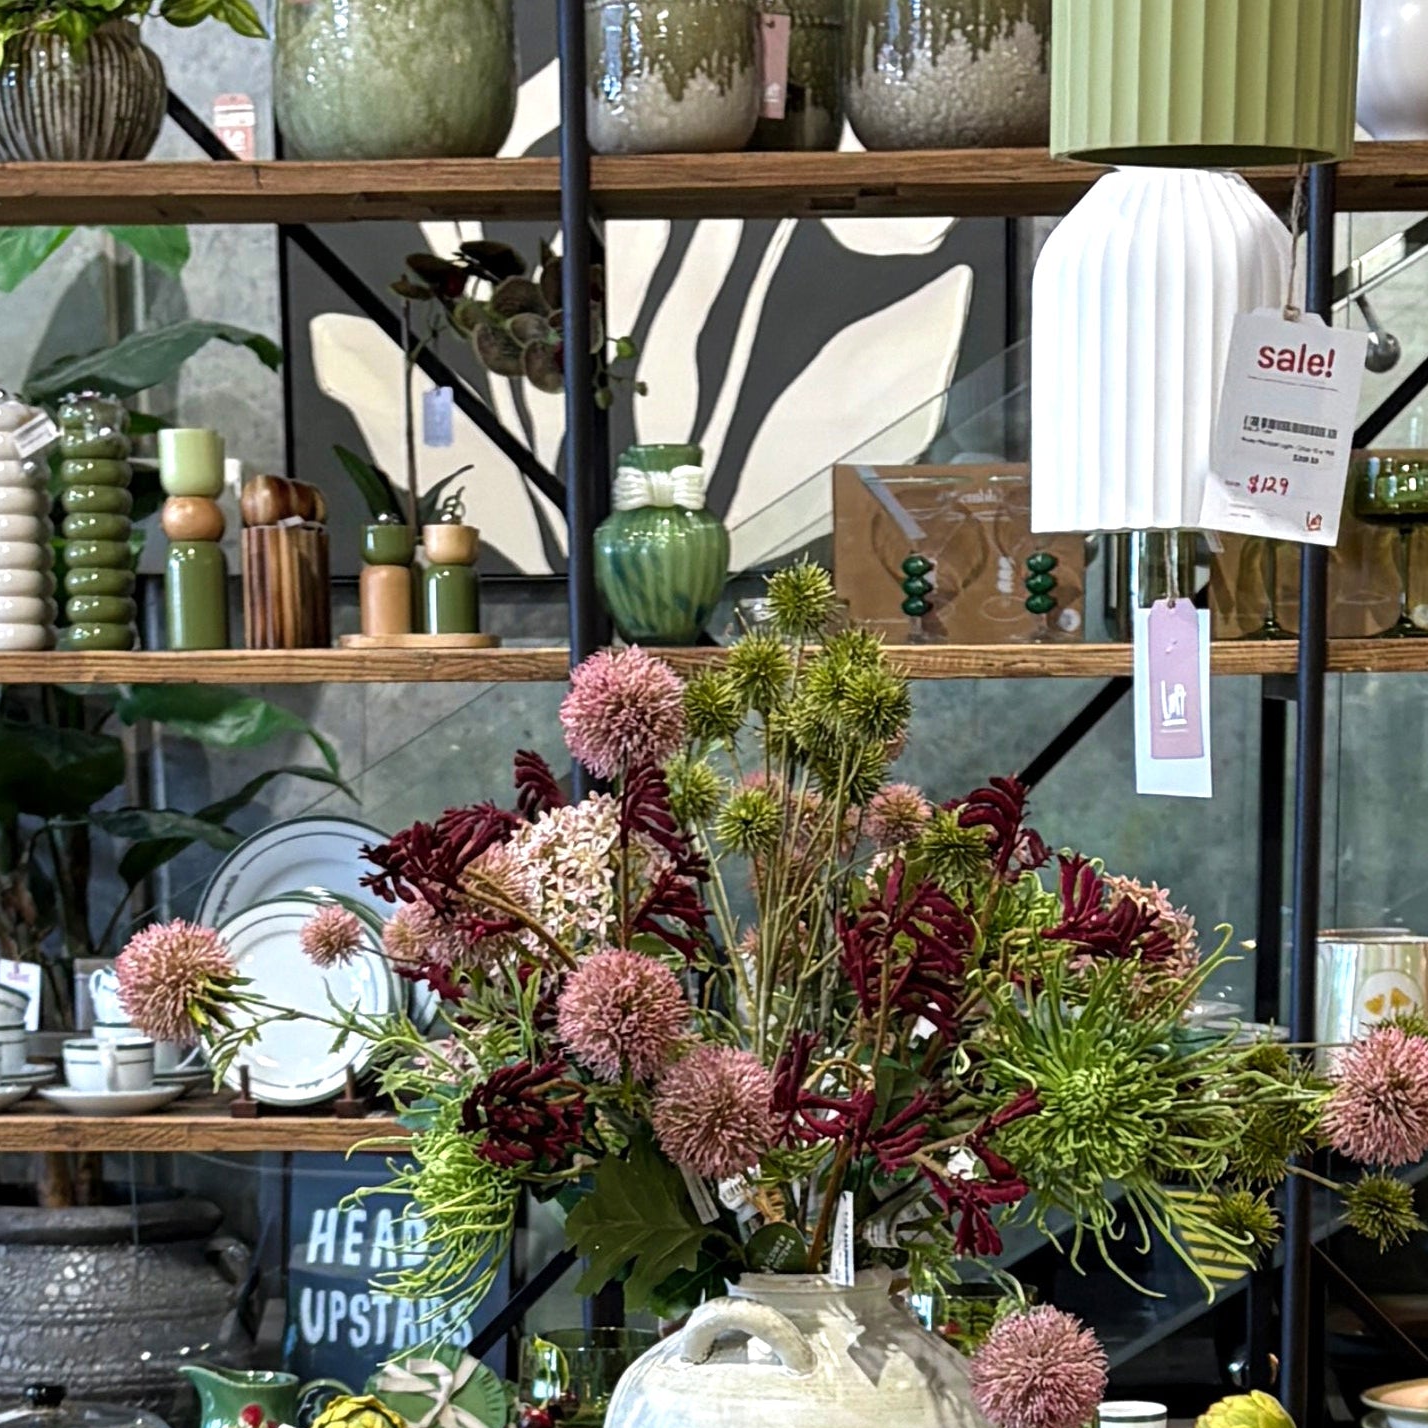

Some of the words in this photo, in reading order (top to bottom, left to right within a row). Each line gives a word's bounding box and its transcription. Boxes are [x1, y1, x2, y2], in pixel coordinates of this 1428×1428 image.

[1257, 343, 1336, 378] sale!
[1247, 474, 1289, 496] $129
[306, 1208, 429, 1269] HEAD
[299, 1287, 473, 1349] UPSTAIRS
